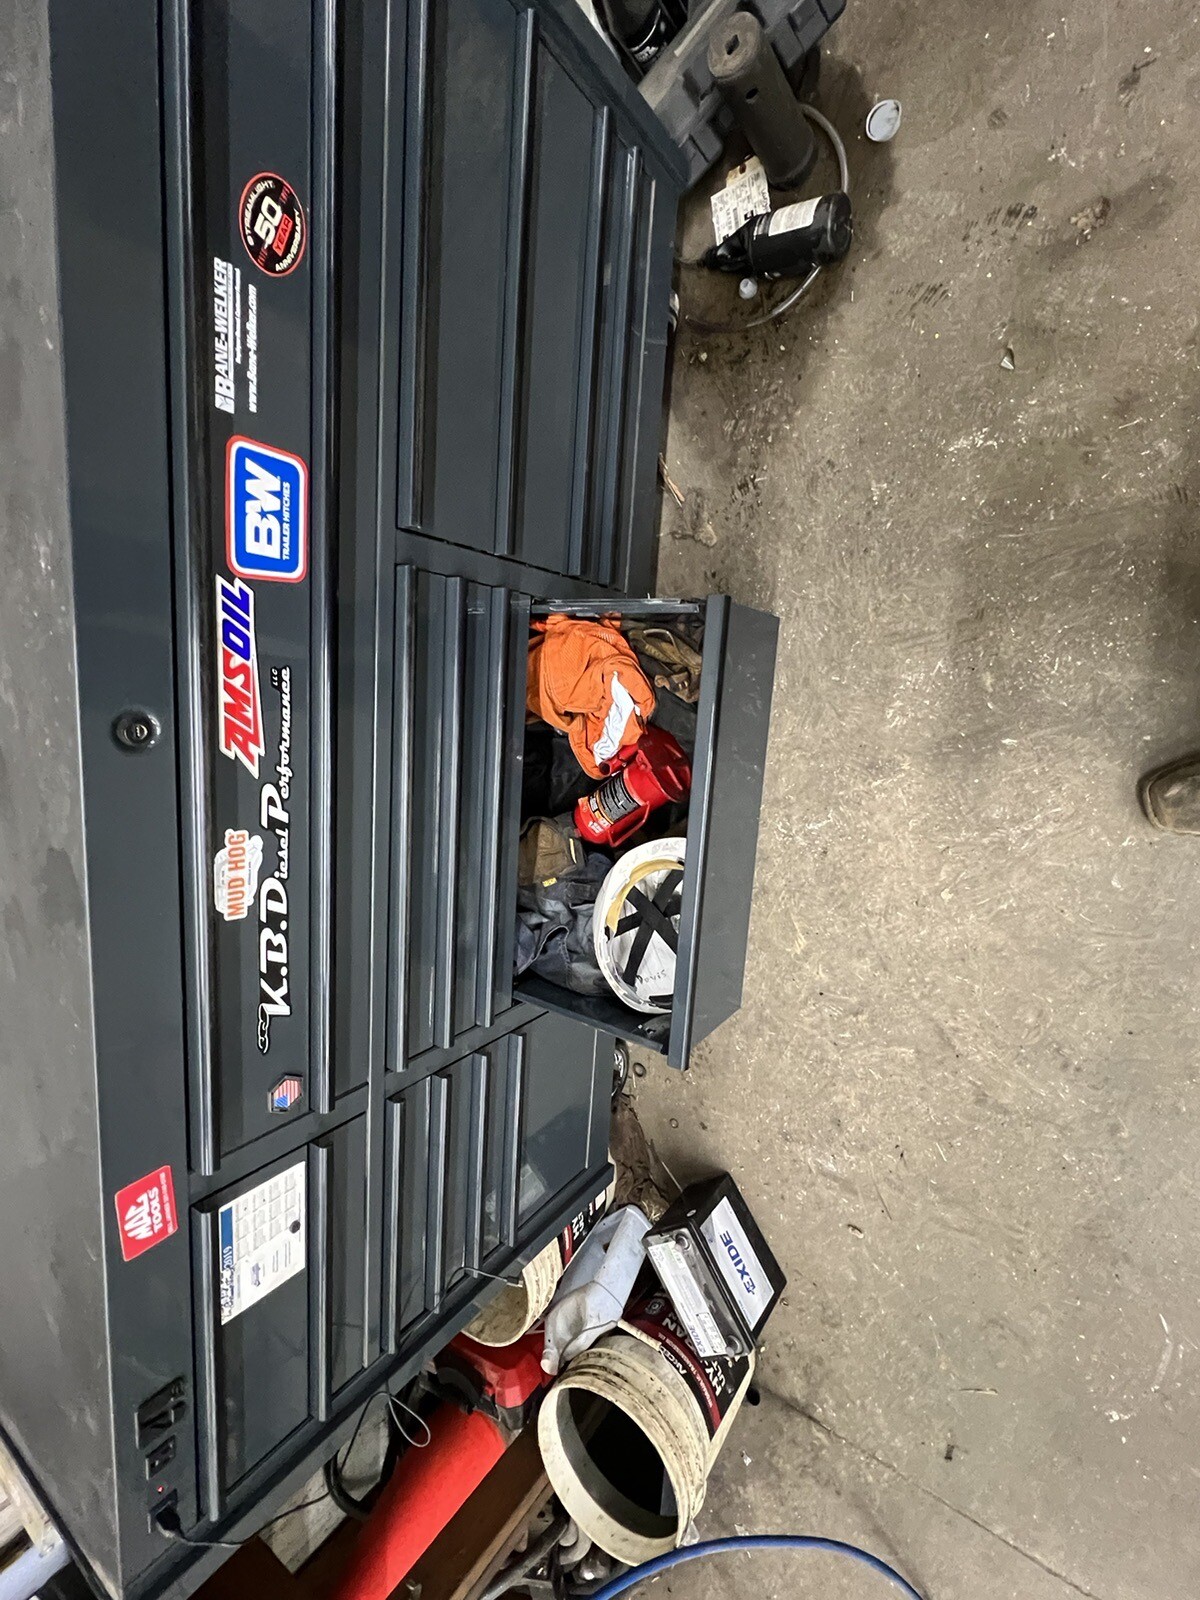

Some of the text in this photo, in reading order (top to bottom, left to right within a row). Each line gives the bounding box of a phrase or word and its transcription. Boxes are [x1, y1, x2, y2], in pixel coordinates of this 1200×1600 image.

[254, 195, 283, 249] 50
[273, 217, 292, 252] YEAR
[275, 208, 301, 271] ANNIVERSARY
[214, 256, 235, 399] BANE-WELKER
[282, 481, 290, 560] TRAILER HITCHES
[221, 584, 261, 765] AMSOIL
[261, 666, 293, 829] Performance
[227, 833, 246, 917] MUD HOG
[124, 1192, 153, 1240] MAC
[148, 1187, 163, 1233] TOOLS
[223, 1246, 233, 1269] 2019
[718, 1230, 756, 1295] EXIDE
[687, 1324, 707, 1354] EXIDE
